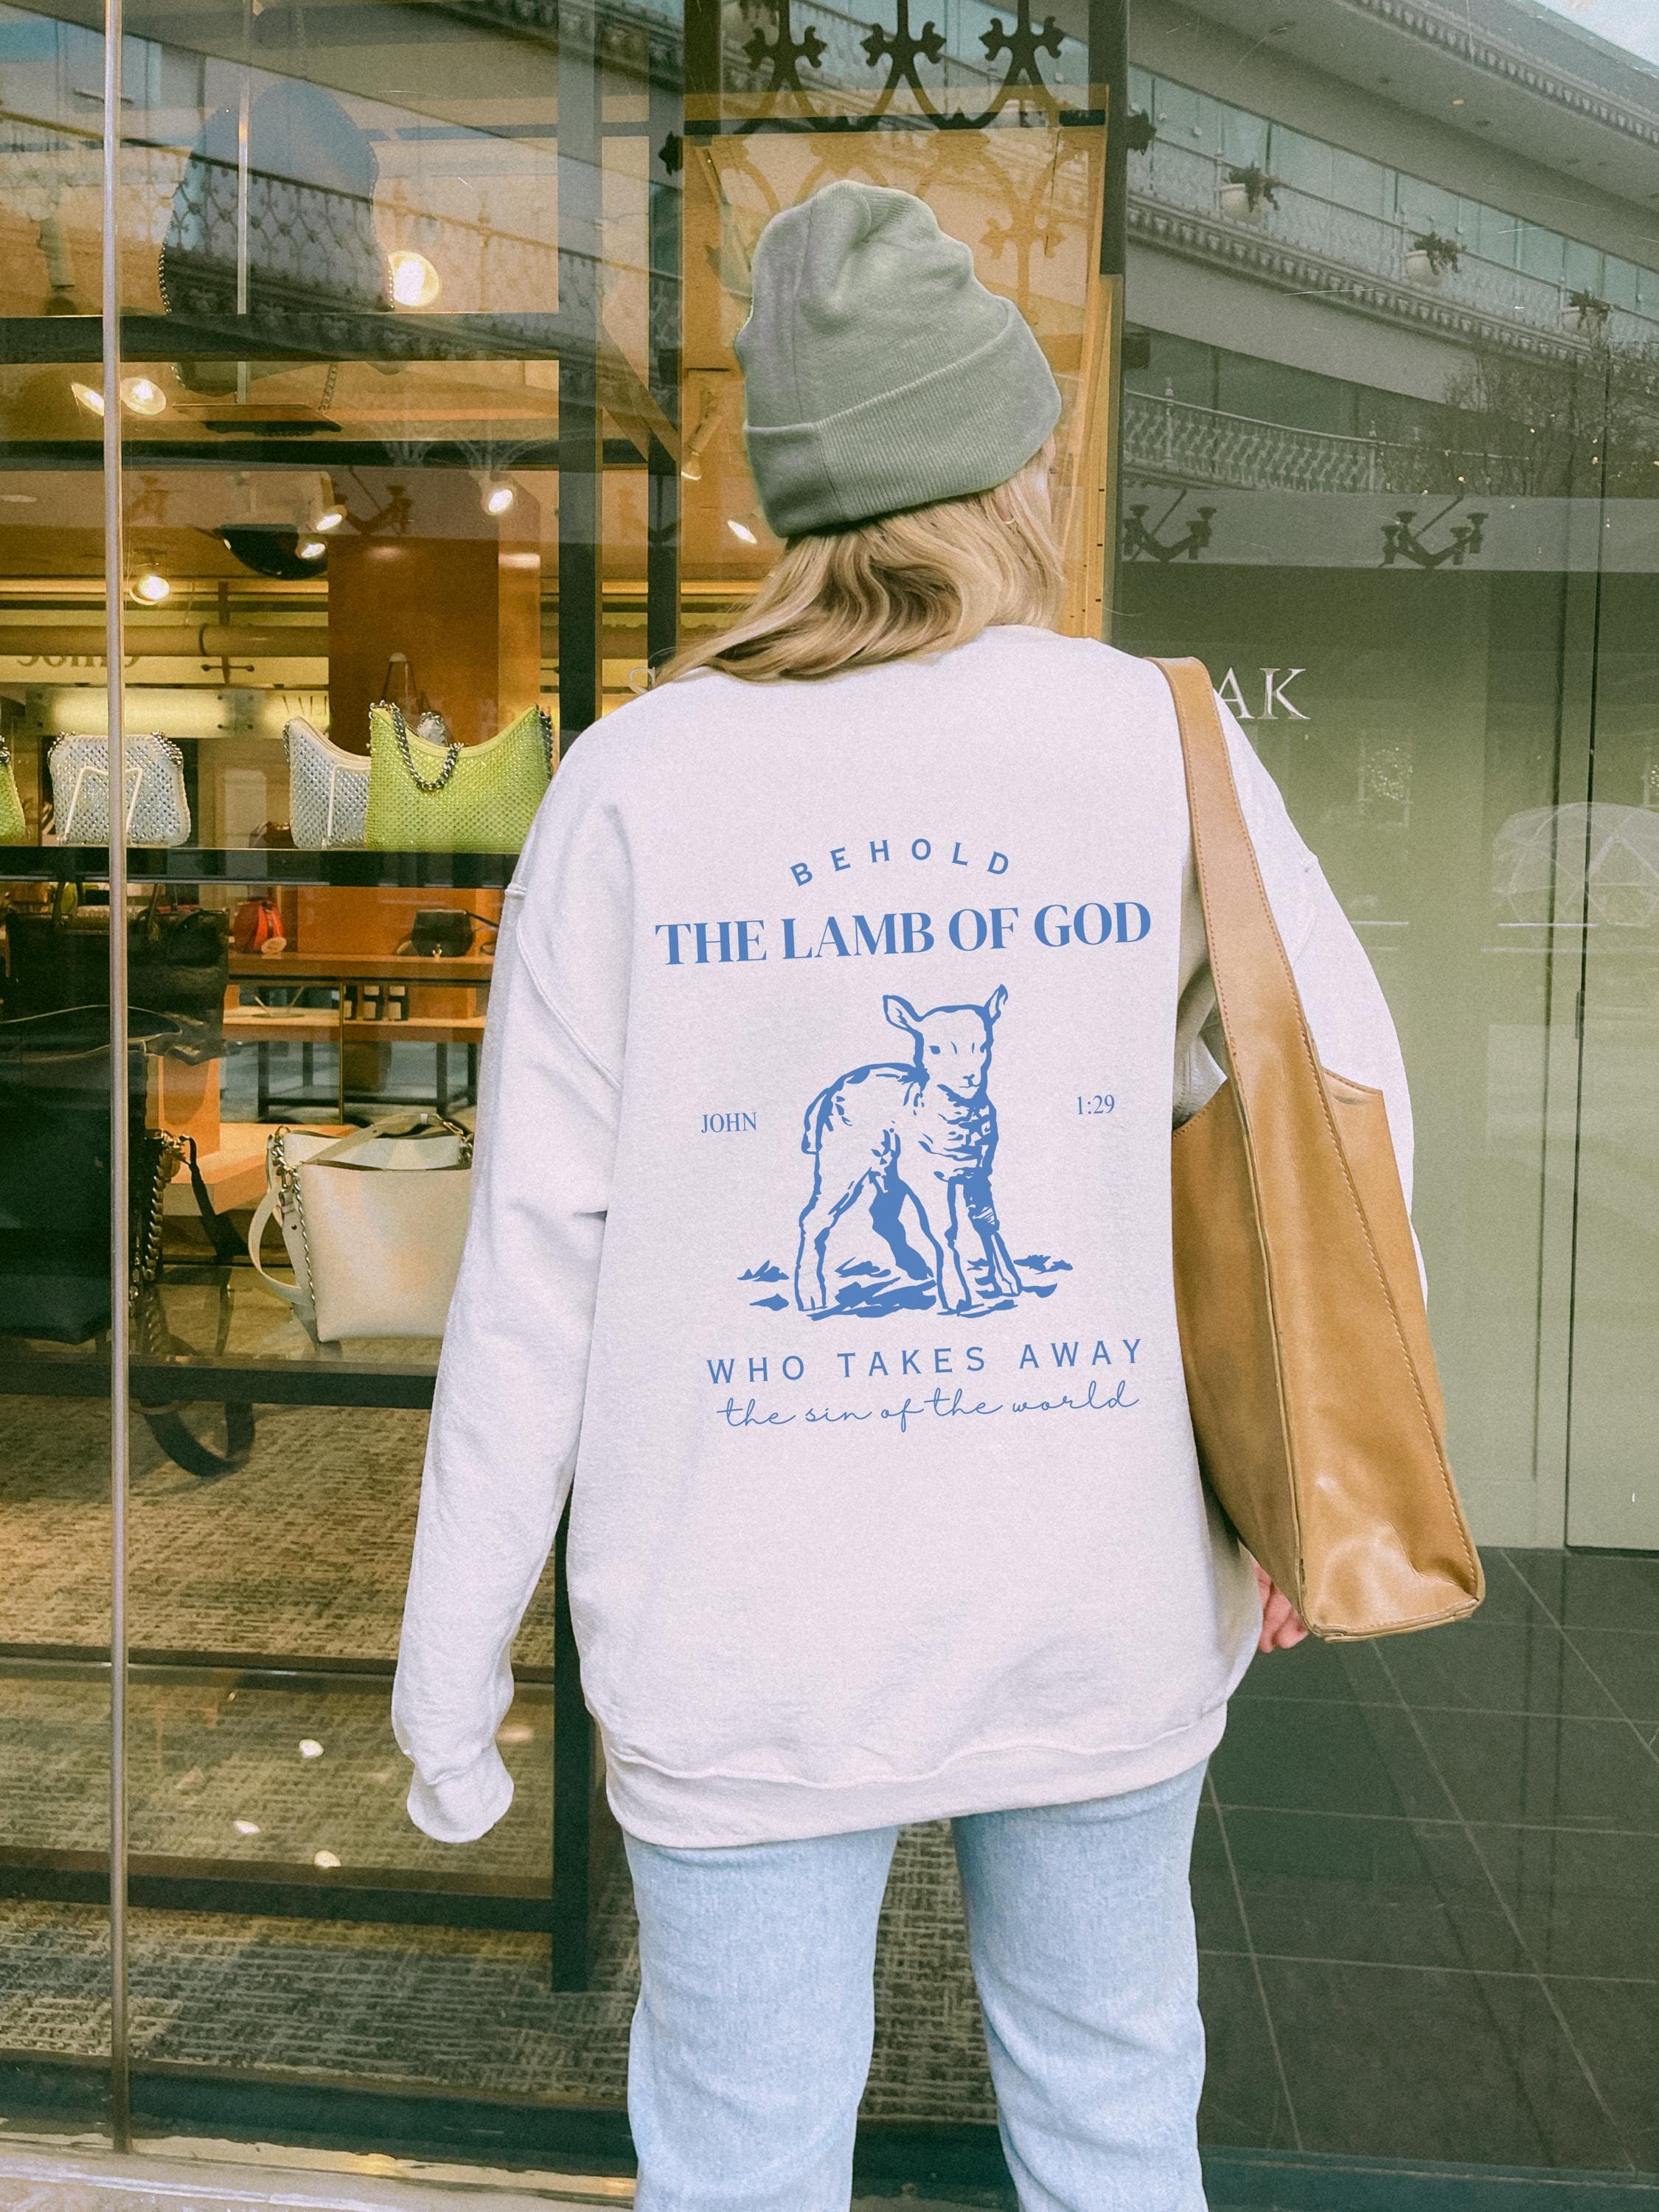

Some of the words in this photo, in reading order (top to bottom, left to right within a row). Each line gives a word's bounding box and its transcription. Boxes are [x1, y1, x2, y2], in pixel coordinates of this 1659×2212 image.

[790, 838, 1009, 887] BEHOLD
[655, 920, 768, 965] THE
[782, 912, 935, 960] LAMB
[948, 908, 1019, 952] OF
[1034, 902, 1151, 947] GOD
[700, 1112, 757, 1133] JOHN
[1077, 1095, 1115, 1115] 1:29
[707, 1355, 805, 1384] WHO
[837, 1346, 985, 1378] TAKES
[1019, 1338, 1141, 1369] AWAY
[716, 1397, 796, 1427] the
[804, 1405, 873, 1423] sin
[880, 1397, 924, 1433] of
[924, 1387, 1004, 1417] the
[1012, 1380, 1140, 1413] world
